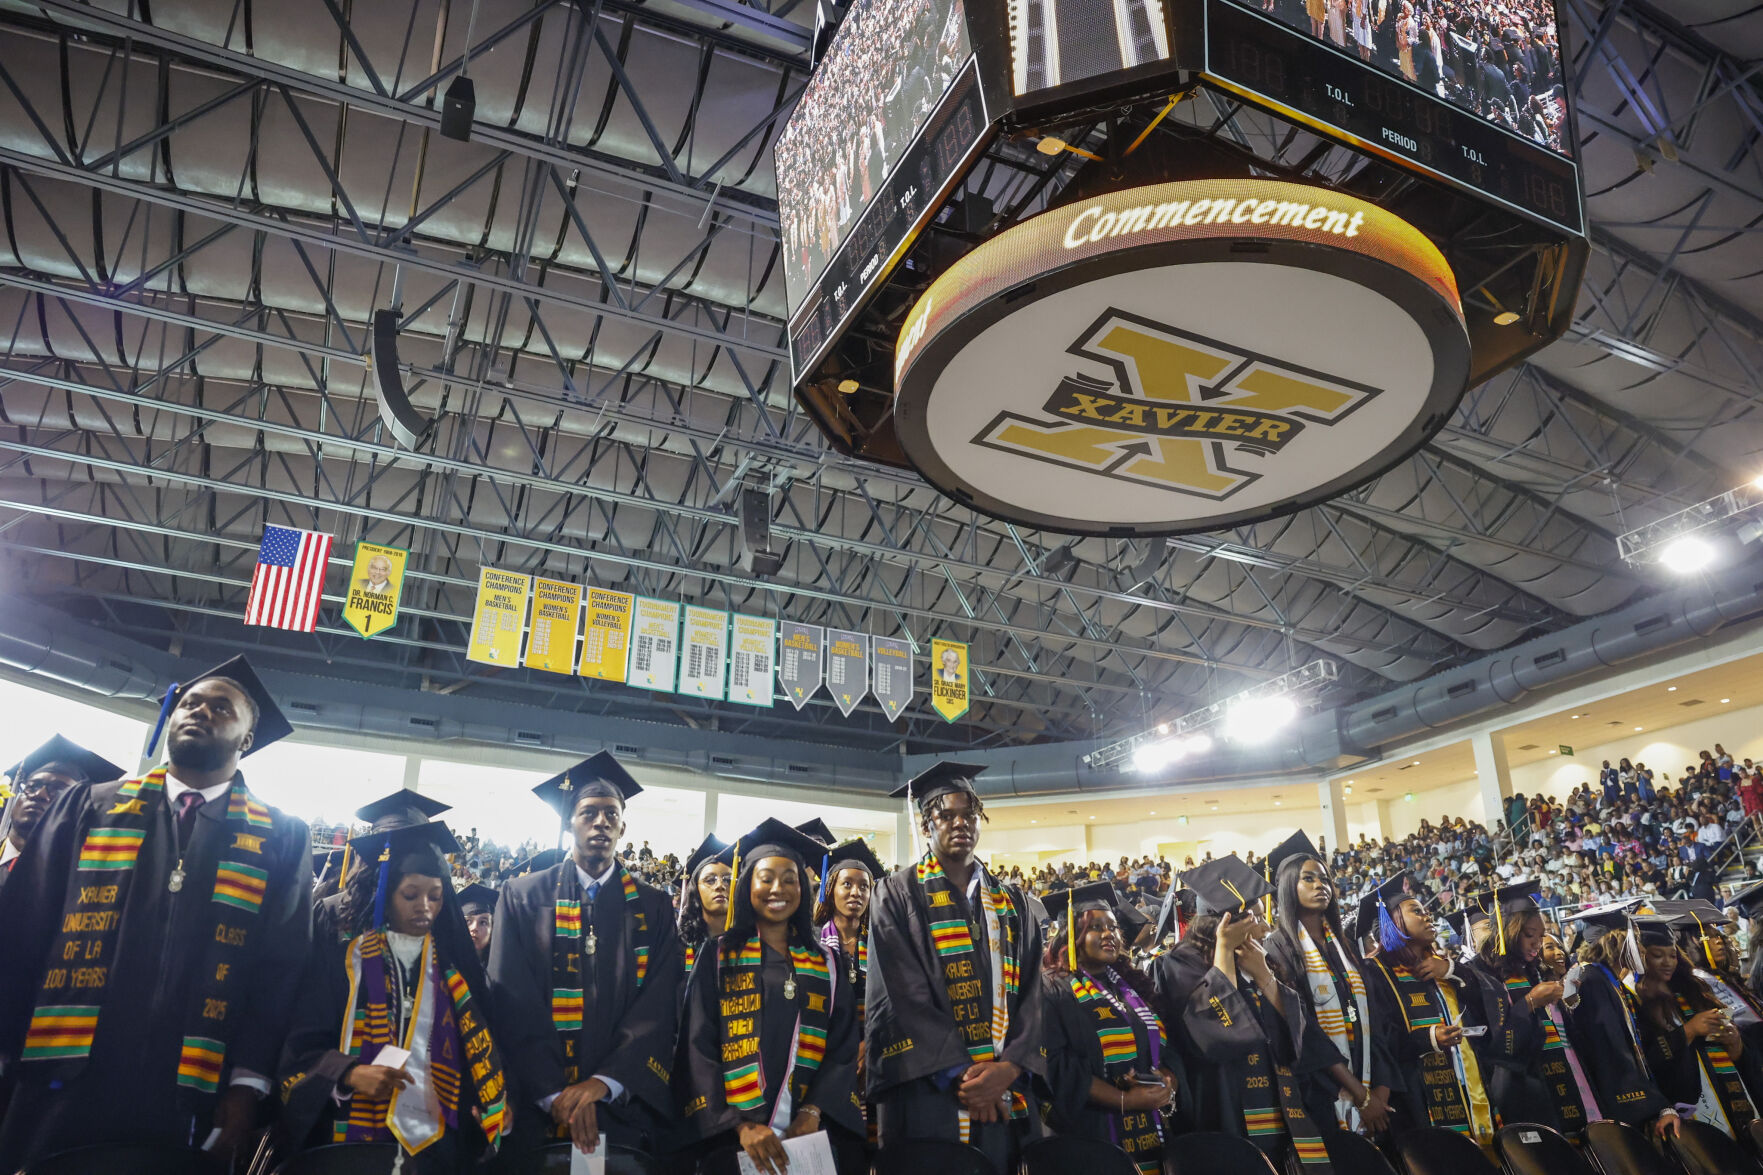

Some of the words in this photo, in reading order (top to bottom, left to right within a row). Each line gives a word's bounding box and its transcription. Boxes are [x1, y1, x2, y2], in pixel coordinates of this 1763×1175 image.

[1325, 84, 1354, 106] T.O.L.
[1382, 127, 1417, 152] PERIOD
[1462, 146, 1488, 166] T.O.L.
[900, 185, 917, 209] T.O.L.
[1064, 196, 1364, 249] Commencement
[860, 253, 879, 284] PERIOD
[1059, 392, 1292, 443] XAVIER
[485, 572, 525, 586] CONFERENCE
[485, 581, 523, 595] CHAMPIONS
[538, 582, 577, 596] CONFERENCE
[352, 589, 361, 597] DR.
[363, 590, 388, 601] NORMAN
[388, 595, 394, 603] C.
[494, 594, 511, 604] MEN'S
[538, 591, 575, 604] CHAMPIONS
[591, 591, 629, 606] CONFERENCE
[349, 597, 394, 615] FRANCIS
[485, 600, 517, 612] BASKETBALL
[543, 604, 568, 613] WOMEN'S
[591, 600, 627, 613] CHAMPIONS
[640, 600, 677, 613] TOURNAMENT
[538, 609, 570, 621] BASKETBALL
[596, 612, 621, 622] WOMEN'S
[640, 609, 674, 622] CHAMPIONS
[688, 609, 726, 621] TOURNAMENT
[364, 614, 371, 633] 1
[592, 619, 622, 630] VOLLEYBALL
[736, 617, 773, 629] TOURNAMENT
[784, 638, 817, 651] BASKETBALL
[793, 633, 811, 642] MEN'S
[835, 640, 860, 650] WOMEN'S
[831, 646, 864, 659] BASKETBALL
[877, 647, 907, 659] VOLLEYBALL
[941, 680, 953, 688] GRACE
[934, 685, 966, 700] FLICKINGER
[78, 885, 119, 905] XAVIER
[63, 910, 120, 934] UNIVERSITY
[216, 924, 246, 947] CLASS
[64, 940, 81, 960] OF
[85, 940, 102, 959] LA
[43, 968, 67, 990] 100
[71, 966, 108, 988] YEARS
[216, 963, 230, 982] OF
[953, 1004, 966, 1021] OF
[967, 1003, 980, 1019] LA
[966, 1021, 991, 1040] YEARS
[882, 1038, 913, 1056] XAVIER
[1248, 1054, 1259, 1065] OF
[1246, 1076, 1269, 1088] 2025
[1433, 1088, 1443, 1102] OF
[1444, 1087, 1454, 1102] LA
[1556, 1083, 1567, 1096] OF
[1616, 1090, 1645, 1101] XAVIER
[1123, 1116, 1135, 1131] OF
[1136, 1112, 1148, 1128] LA
[1136, 1132, 1160, 1150] YEARS
